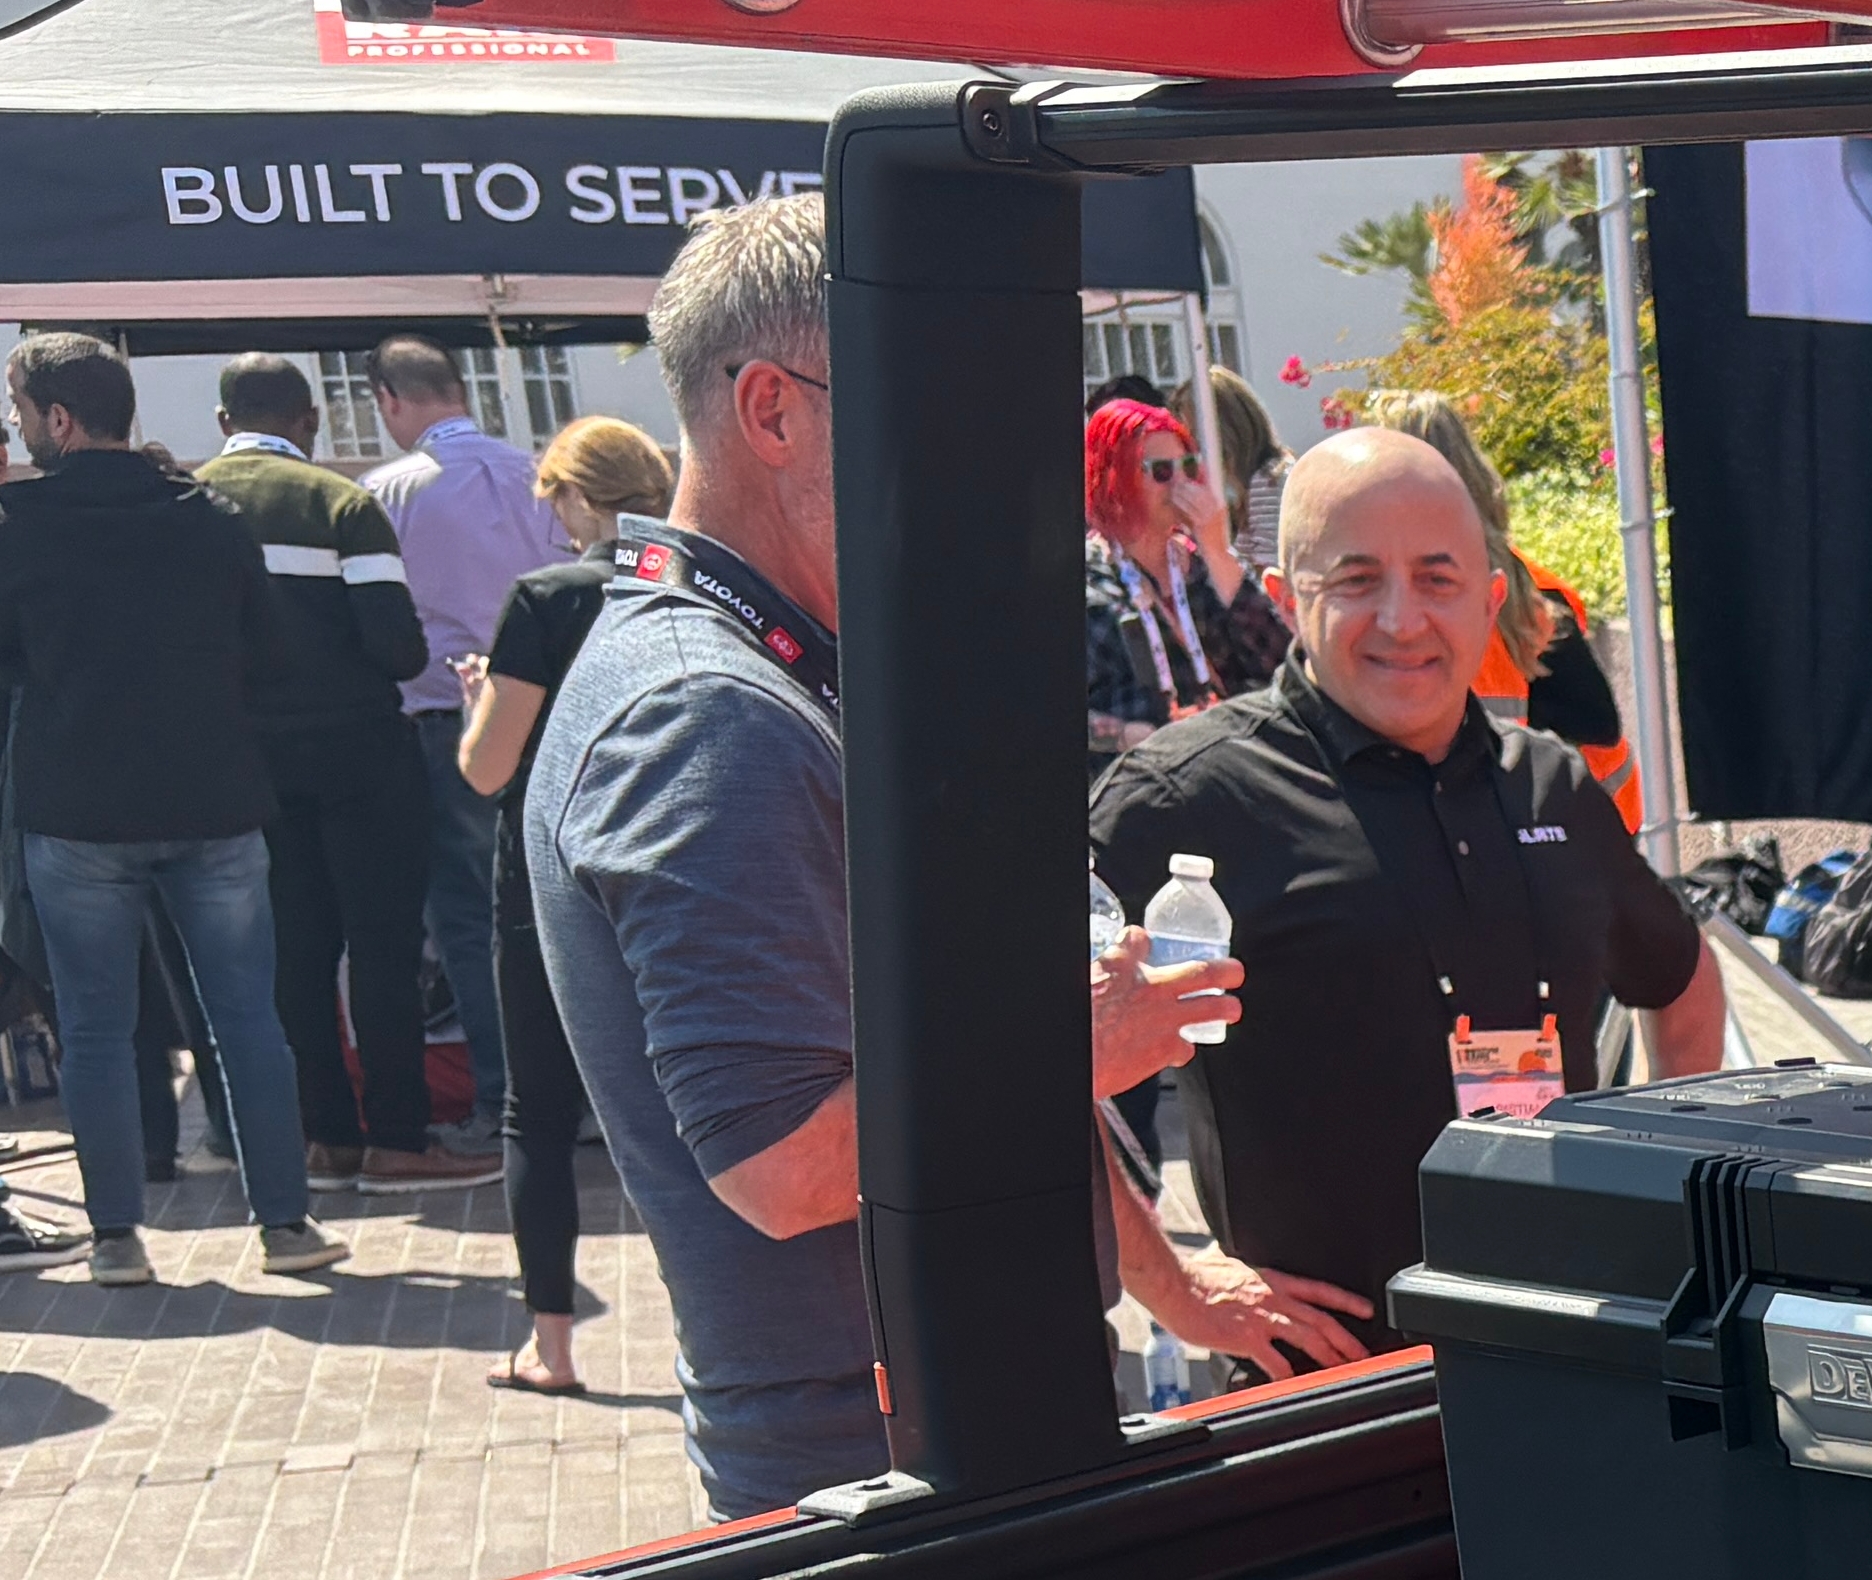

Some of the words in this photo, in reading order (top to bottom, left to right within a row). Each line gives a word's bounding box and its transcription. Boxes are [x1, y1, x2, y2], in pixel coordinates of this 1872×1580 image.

[347, 43, 591, 57] PROFESSIONAL
[160, 165, 402, 224] BUILT
[421, 162, 541, 222] TO
[694, 570, 765, 629] TOYOTA
